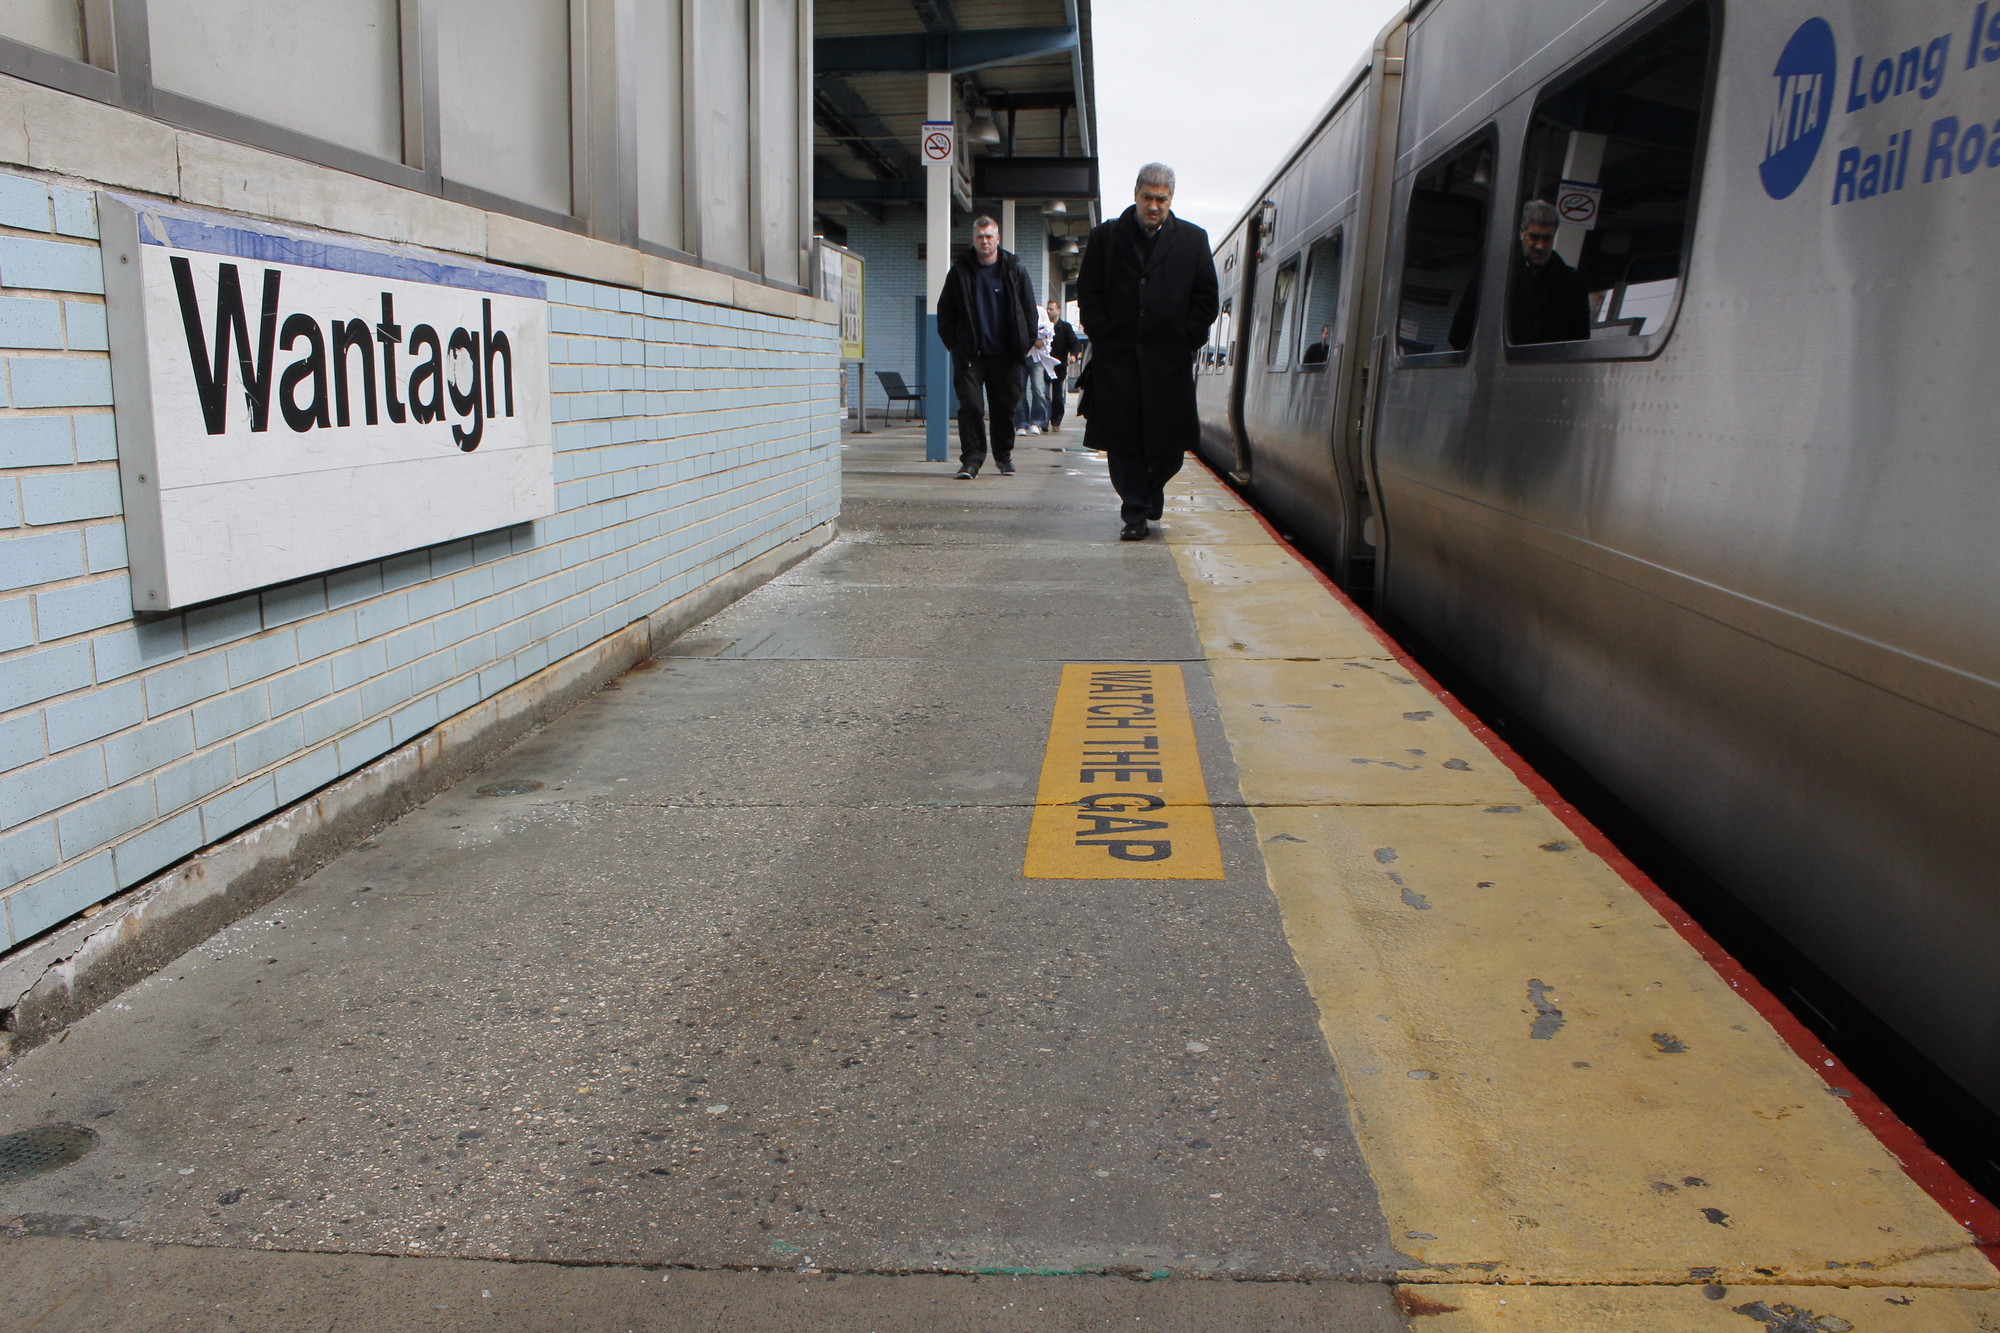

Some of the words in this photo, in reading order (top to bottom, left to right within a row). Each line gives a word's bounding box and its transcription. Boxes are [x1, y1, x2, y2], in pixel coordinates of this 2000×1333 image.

[1846, 32, 1952, 114] Long
[1767, 73, 1823, 158] MTA
[1831, 128, 1912, 206] Rail
[169, 256, 514, 453] Wantagh
[1086, 669, 1157, 728] WATCH
[1081, 736, 1163, 783] THE
[1075, 793, 1172, 862] GAP
